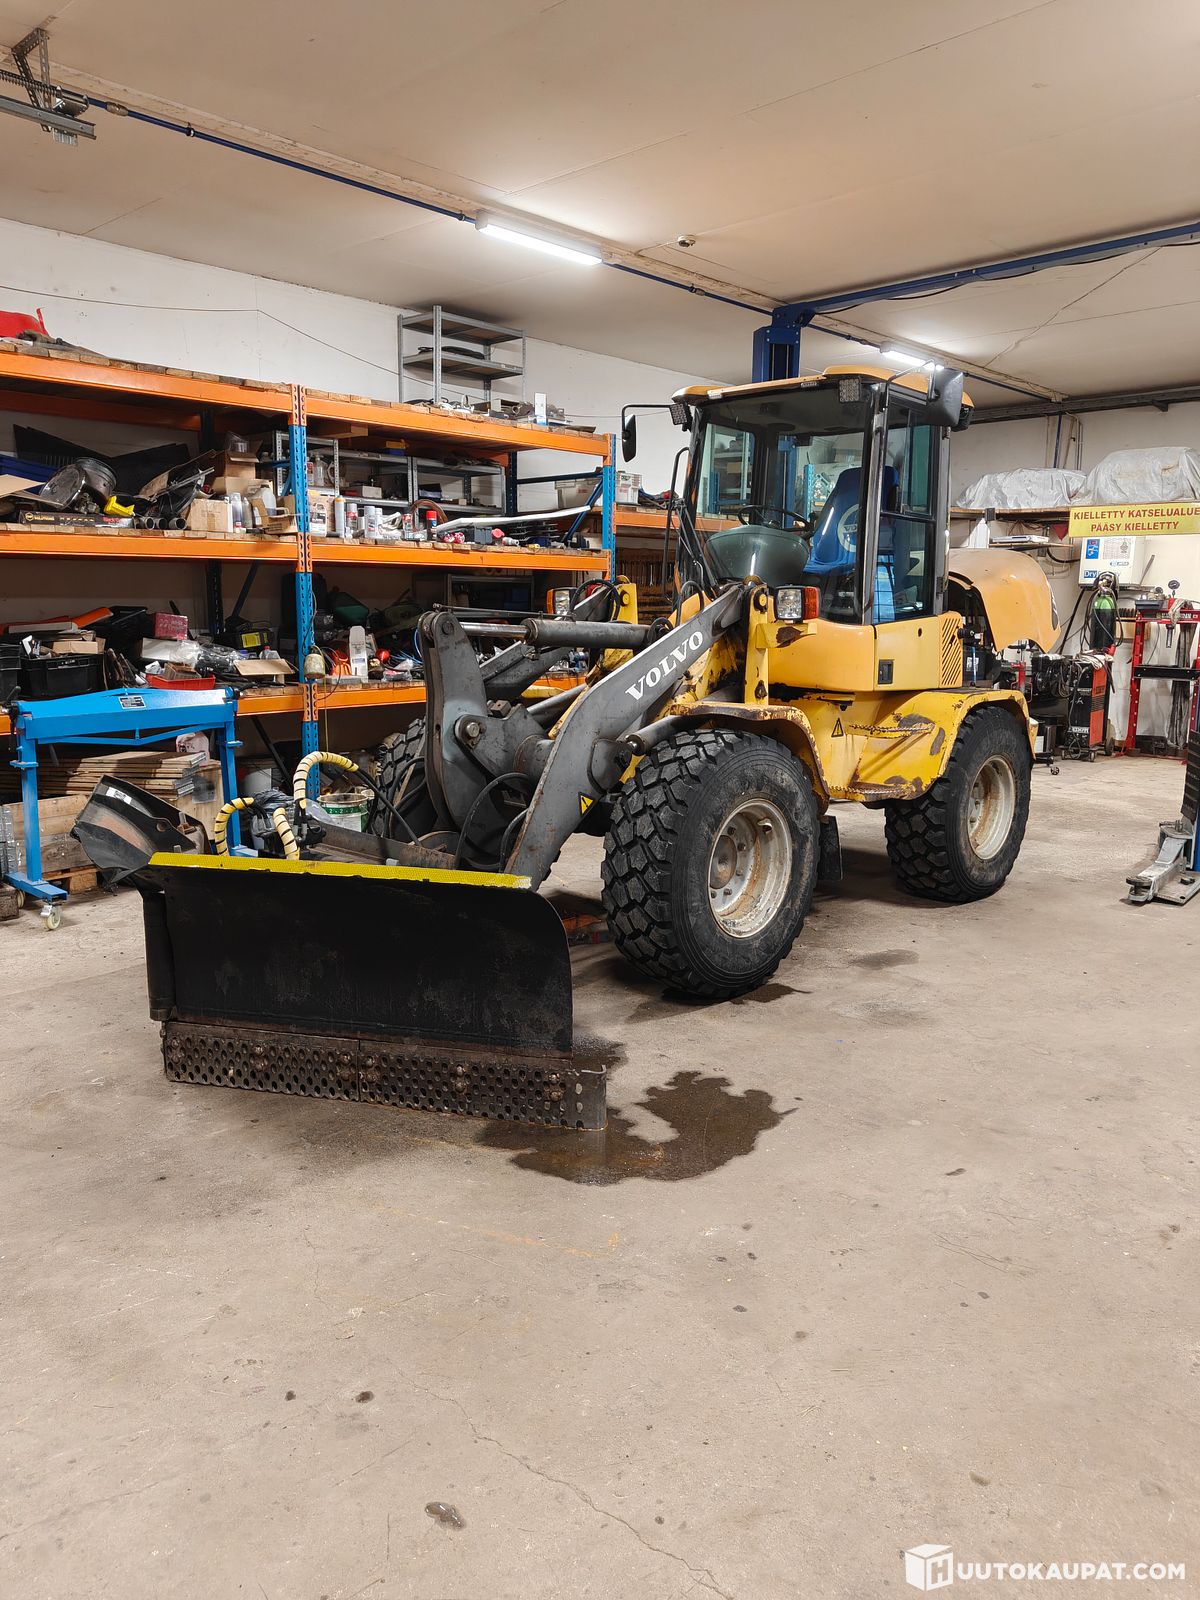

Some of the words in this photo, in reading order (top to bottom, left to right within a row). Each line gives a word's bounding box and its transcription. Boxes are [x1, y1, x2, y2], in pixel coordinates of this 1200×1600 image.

[1074, 510, 1125, 520] KIELLETTY
[1128, 508, 1200, 518] KATSELUALUE
[1091, 522, 1122, 532] PÄÄSY
[1124, 521, 1180, 531] KIELLETTY
[625, 631, 703, 700] VOLVO
